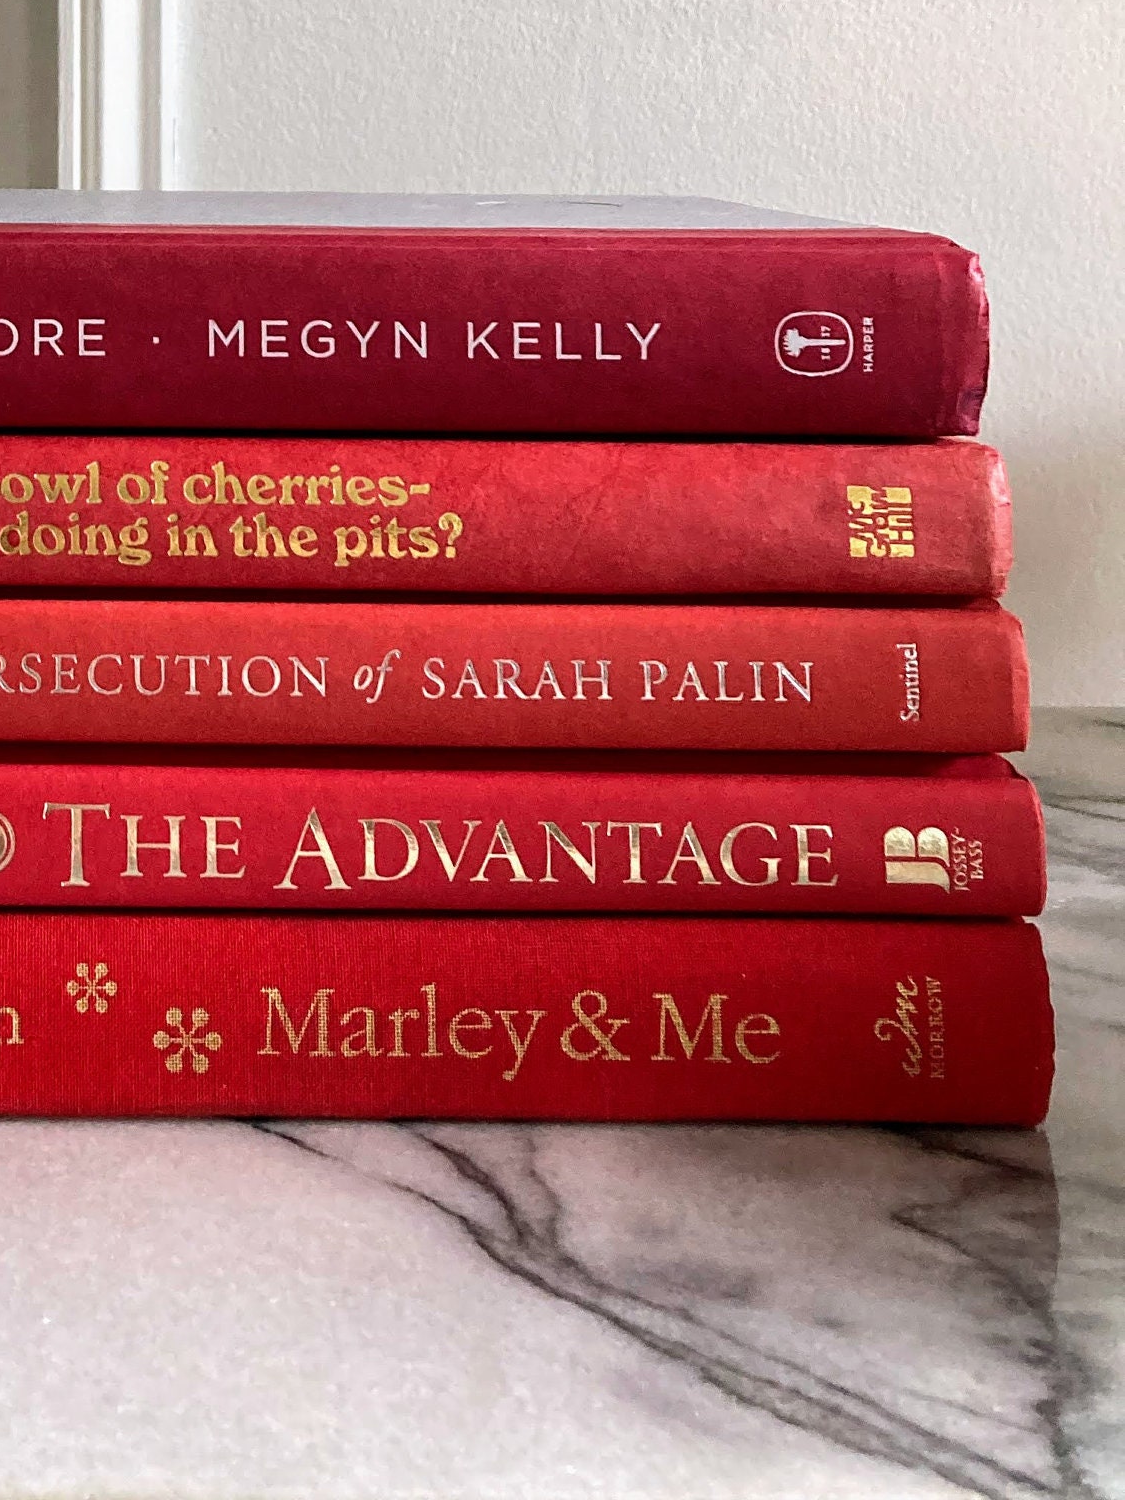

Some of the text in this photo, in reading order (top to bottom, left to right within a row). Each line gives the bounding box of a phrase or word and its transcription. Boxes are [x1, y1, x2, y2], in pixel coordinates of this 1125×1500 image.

[208, 319, 662, 361] MEGYN KELLY
[862, 316, 874, 373] HARPER
[117, 461, 170, 505] of
[183, 462, 431, 506] cherries-
[0, 513, 152, 566] doing
[166, 515, 218, 557] in
[229, 513, 318, 558] the
[333, 513, 464, 567] pits?
[352, 649, 402, 705] of
[421, 660, 614, 701] SARAH
[639, 661, 814, 704] PALIN
[896, 643, 920, 721] Sentinel
[968, 841, 984, 879] BASS
[257, 981, 782, 1082] Marley & Me
[926, 975, 944, 1079] MORROW
